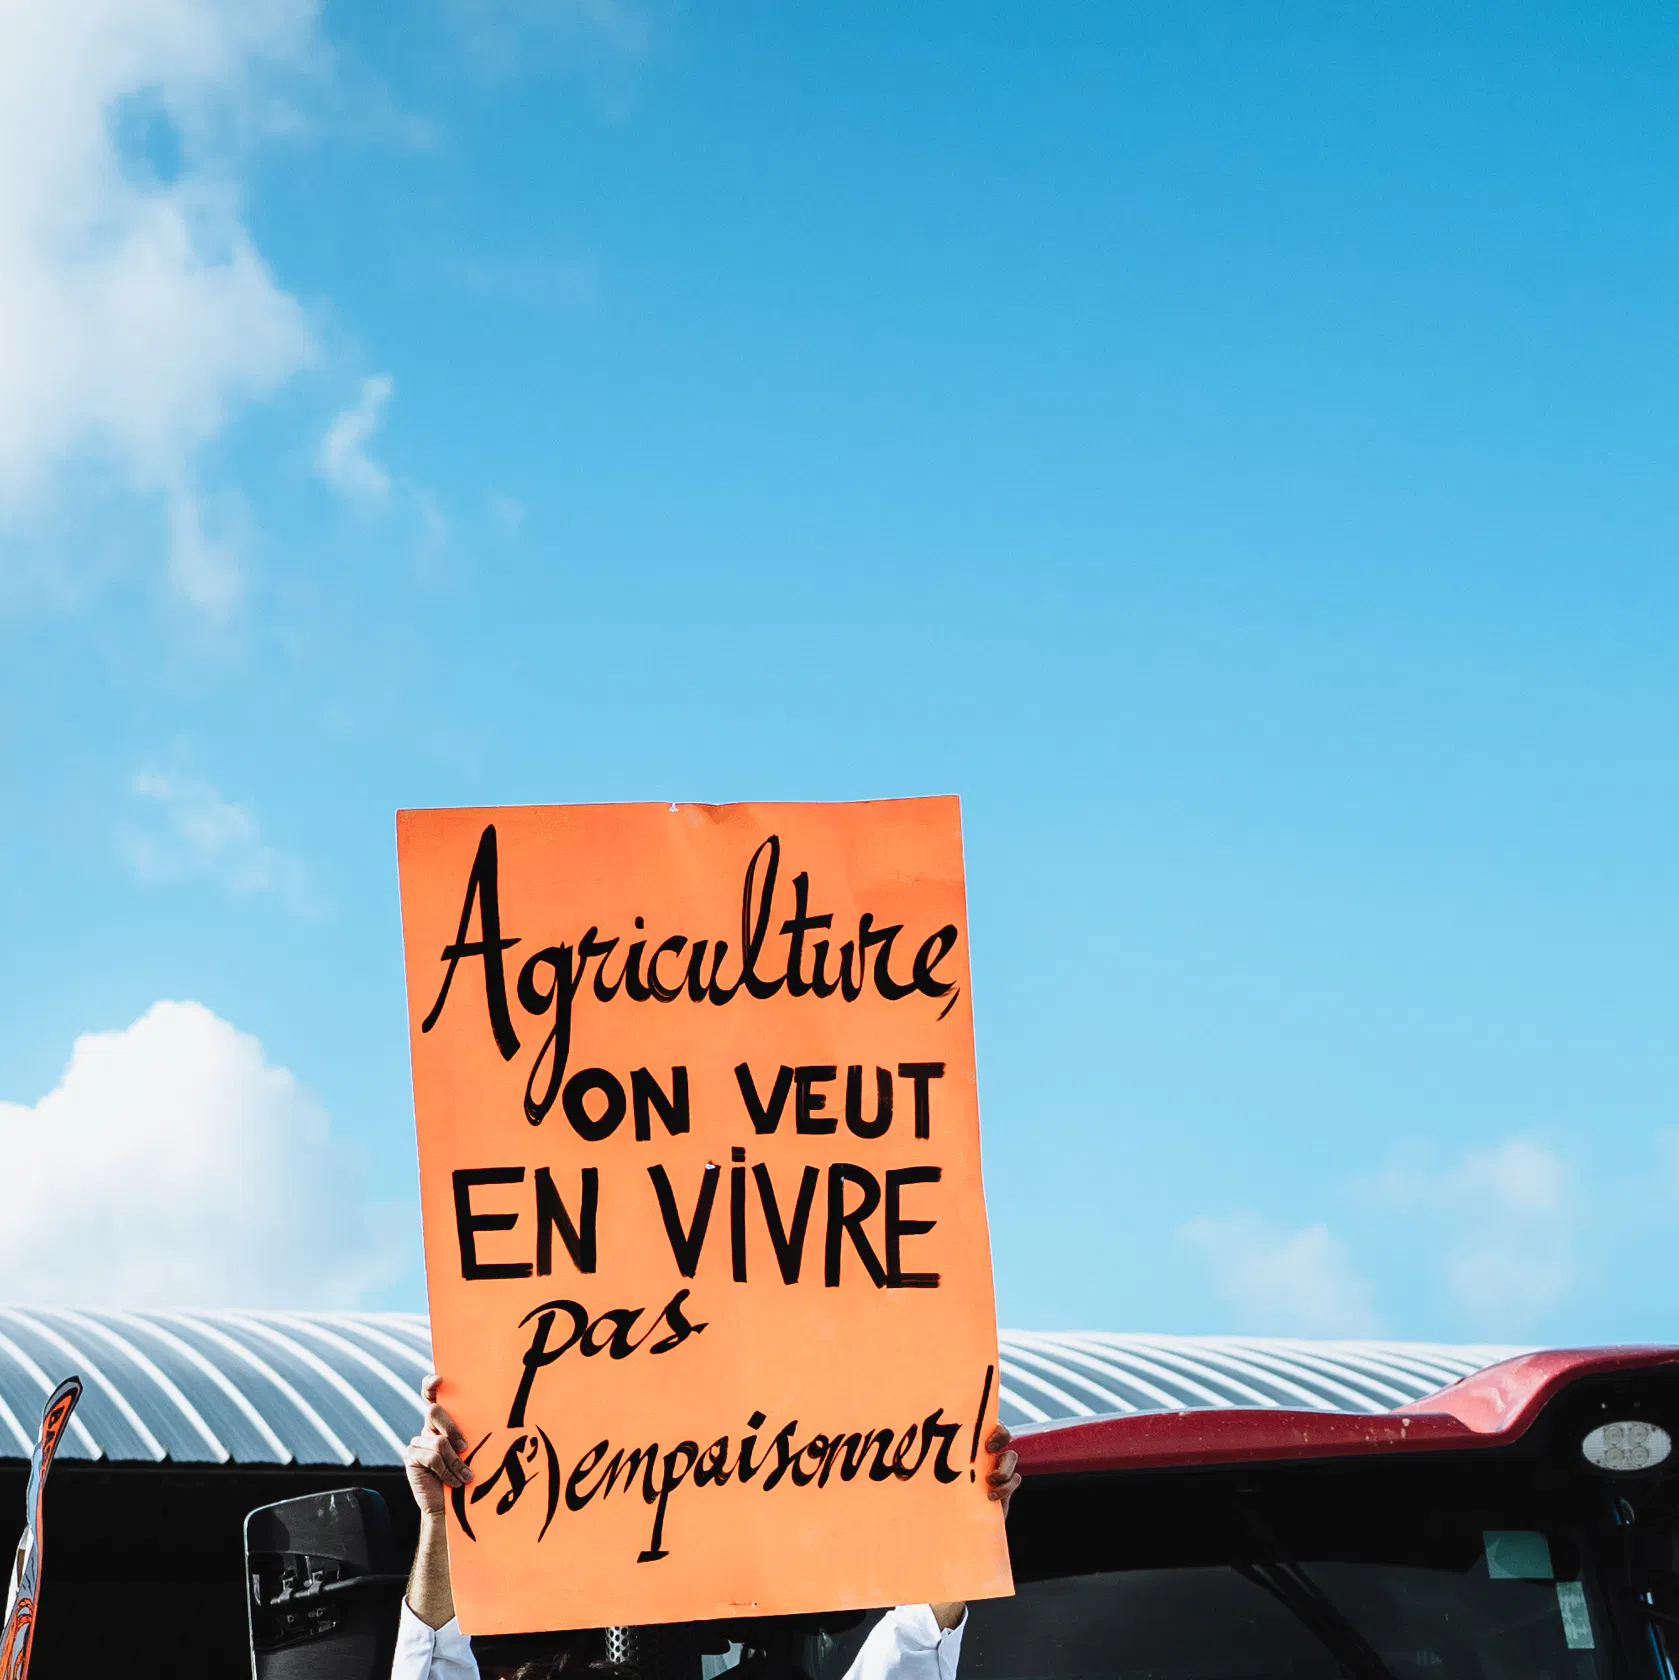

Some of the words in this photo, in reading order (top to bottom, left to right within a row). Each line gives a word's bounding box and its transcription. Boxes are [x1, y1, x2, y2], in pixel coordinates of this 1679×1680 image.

[422, 824, 962, 1127] Agriculture,
[562, 1065, 690, 1143] ON
[734, 1062, 946, 1141] VEUT
[452, 1166, 600, 1282] EN
[507, 1288, 710, 1428] pas
